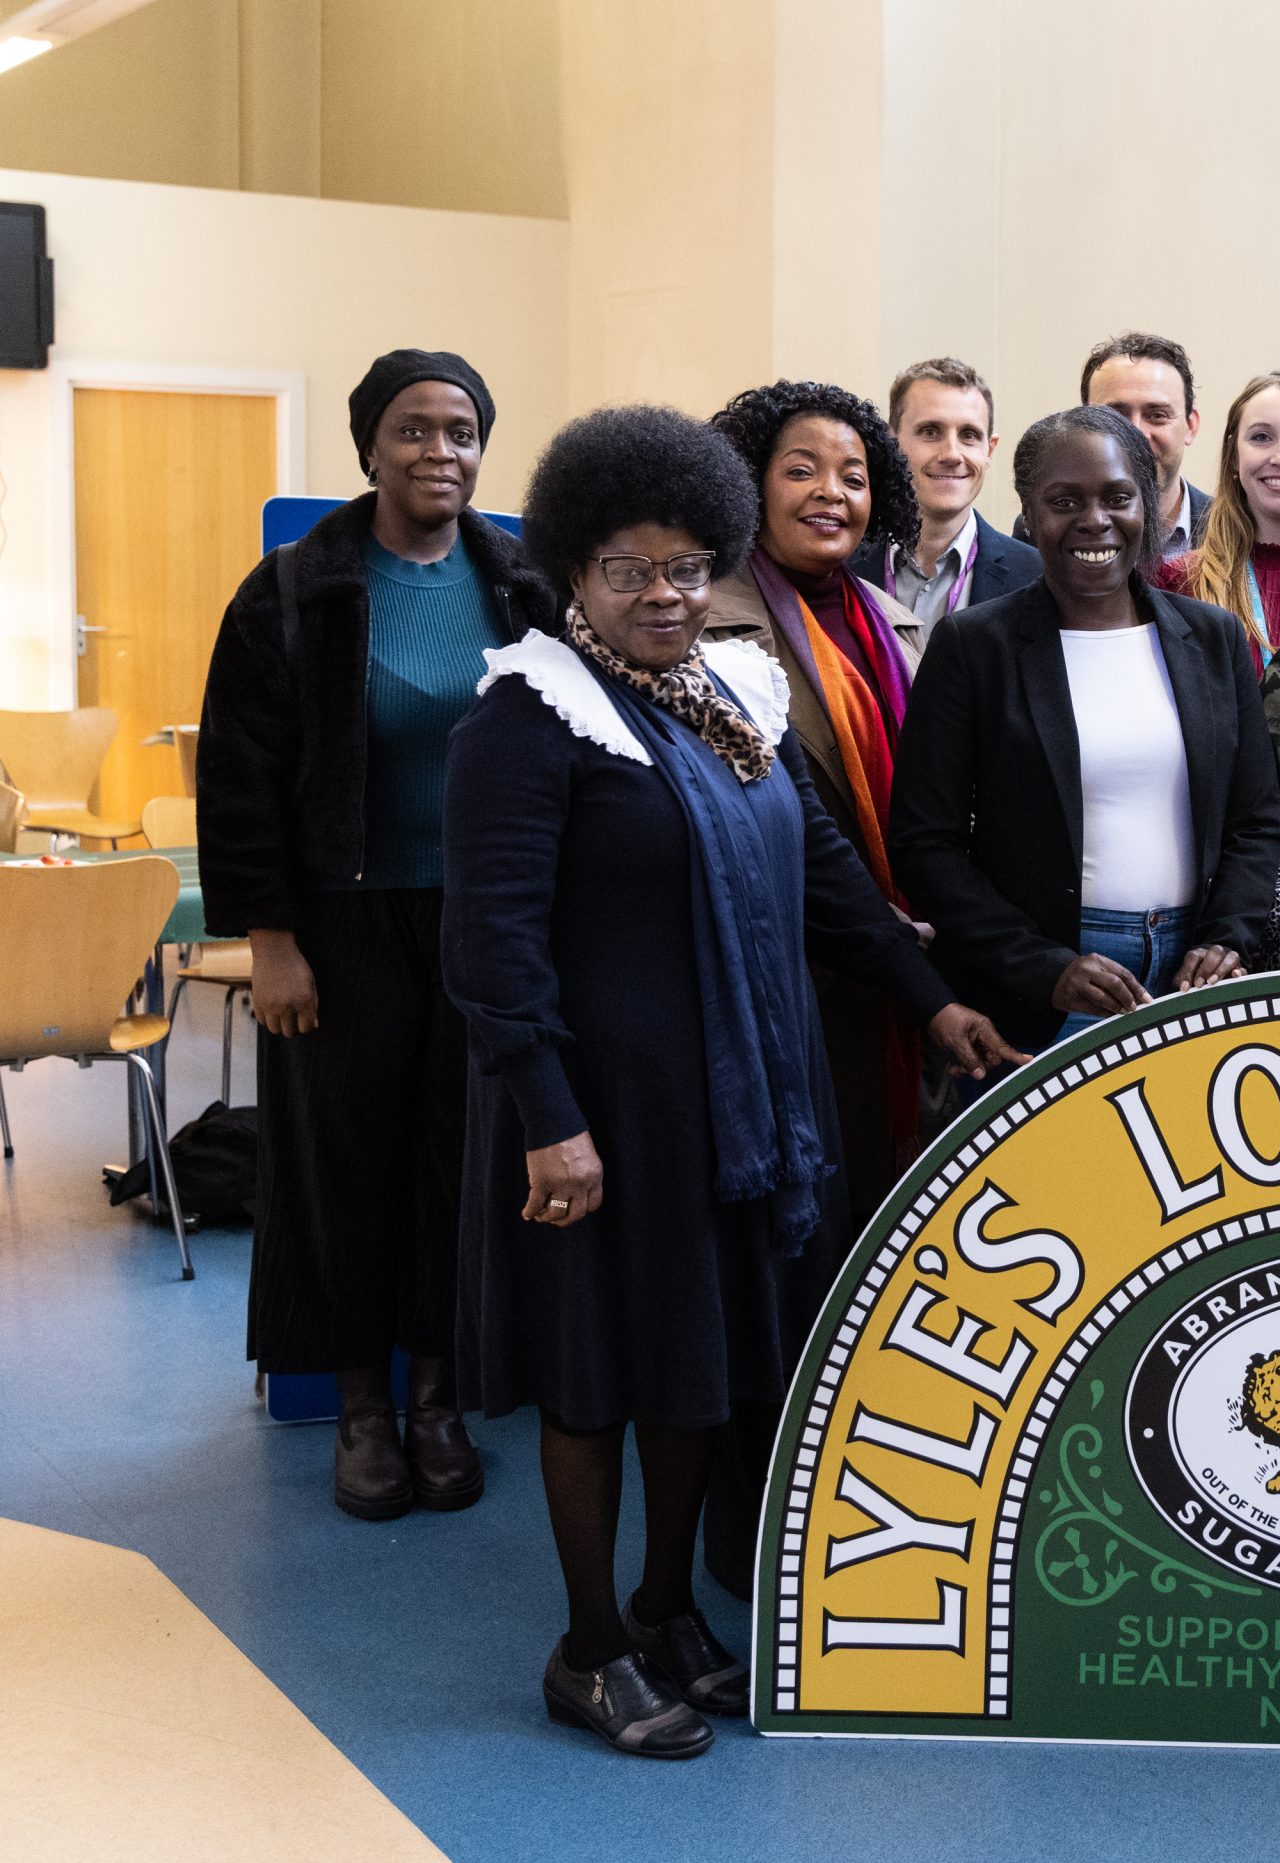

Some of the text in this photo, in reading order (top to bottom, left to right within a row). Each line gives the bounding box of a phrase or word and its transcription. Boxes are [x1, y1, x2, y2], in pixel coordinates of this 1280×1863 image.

[823, 1177, 1085, 1658] LYLE'S
[1201, 1467, 1229, 1495] OUT
[1228, 1493, 1249, 1511] OF
[1249, 1506, 1279, 1529] THE
